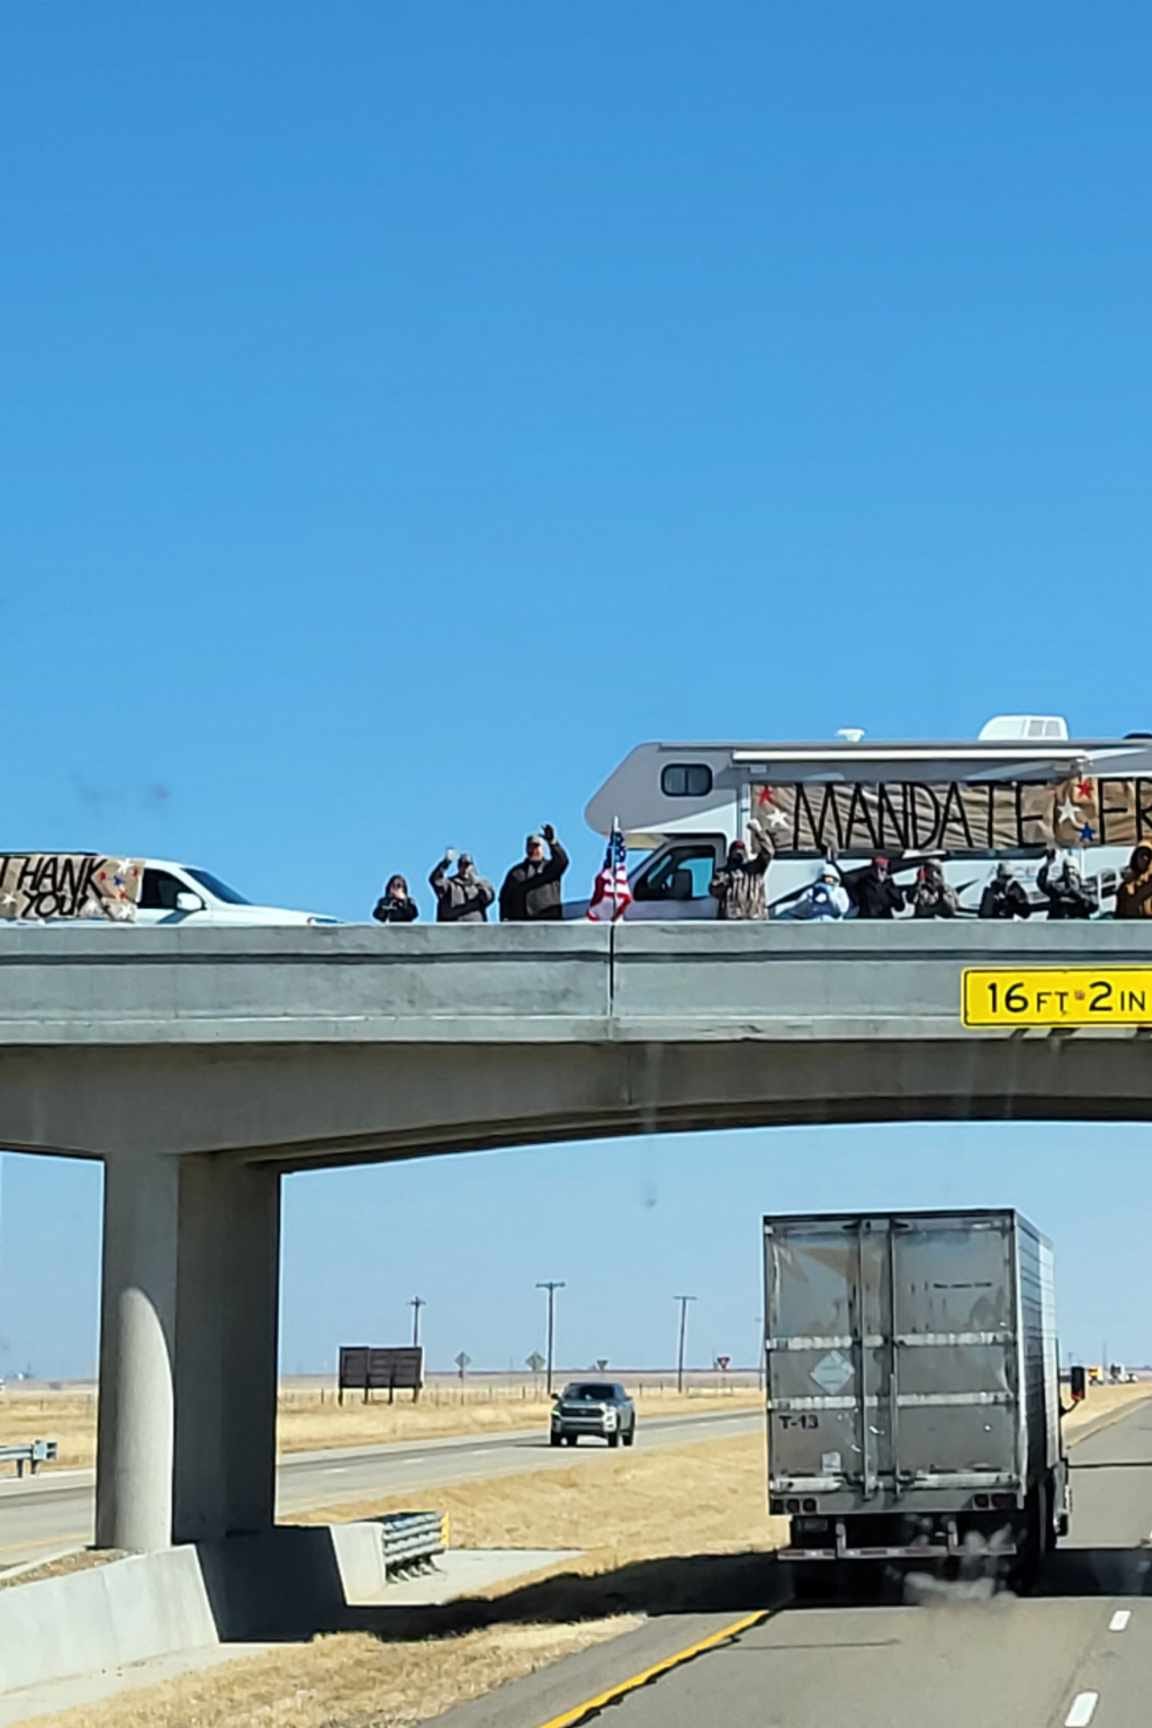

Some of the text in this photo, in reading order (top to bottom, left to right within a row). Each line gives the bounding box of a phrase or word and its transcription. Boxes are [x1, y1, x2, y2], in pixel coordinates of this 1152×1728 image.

[794, 781, 1047, 850] MANDATE
[987, 981, 1146, 1014] 16 FT 2 IN
